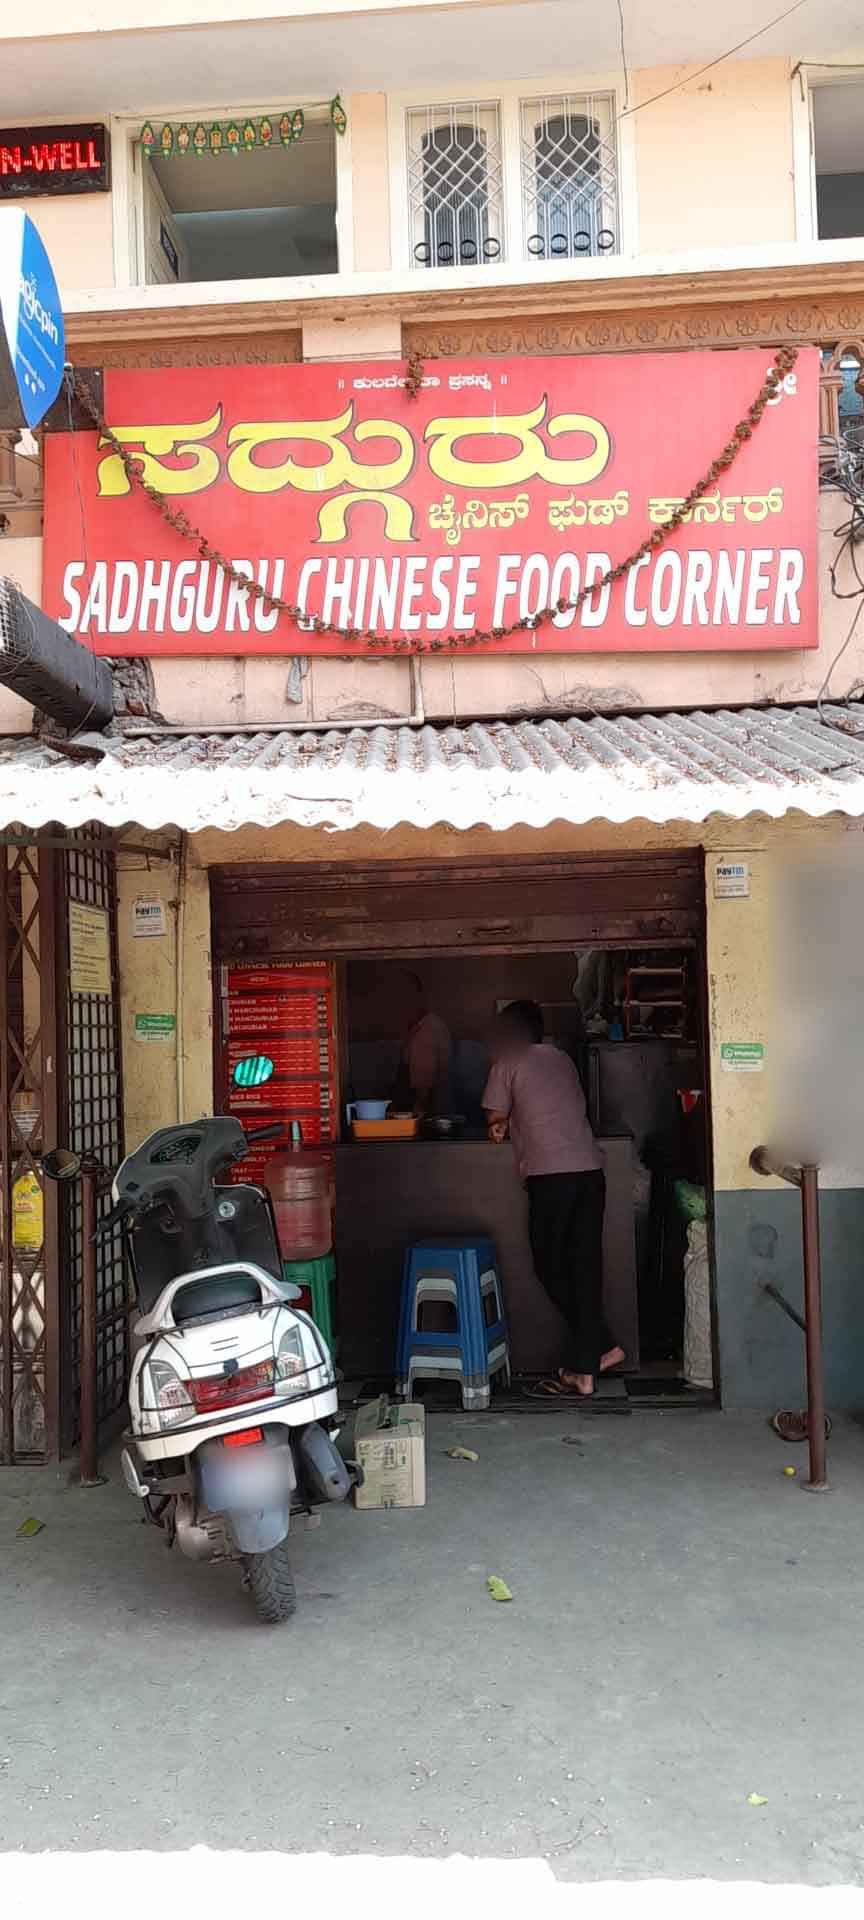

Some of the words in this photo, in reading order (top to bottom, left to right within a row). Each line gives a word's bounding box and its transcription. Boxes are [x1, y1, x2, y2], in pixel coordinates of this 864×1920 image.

[97, 393, 611, 543] ಸದ್ಗುರು
[427, 494, 529, 546] ಚೈನಿಸ್
[58, 558, 284, 634] SADHGURU
[297, 555, 480, 633] CHINESE
[491, 552, 611, 628] FOOD
[624, 548, 804, 627] CORNER
